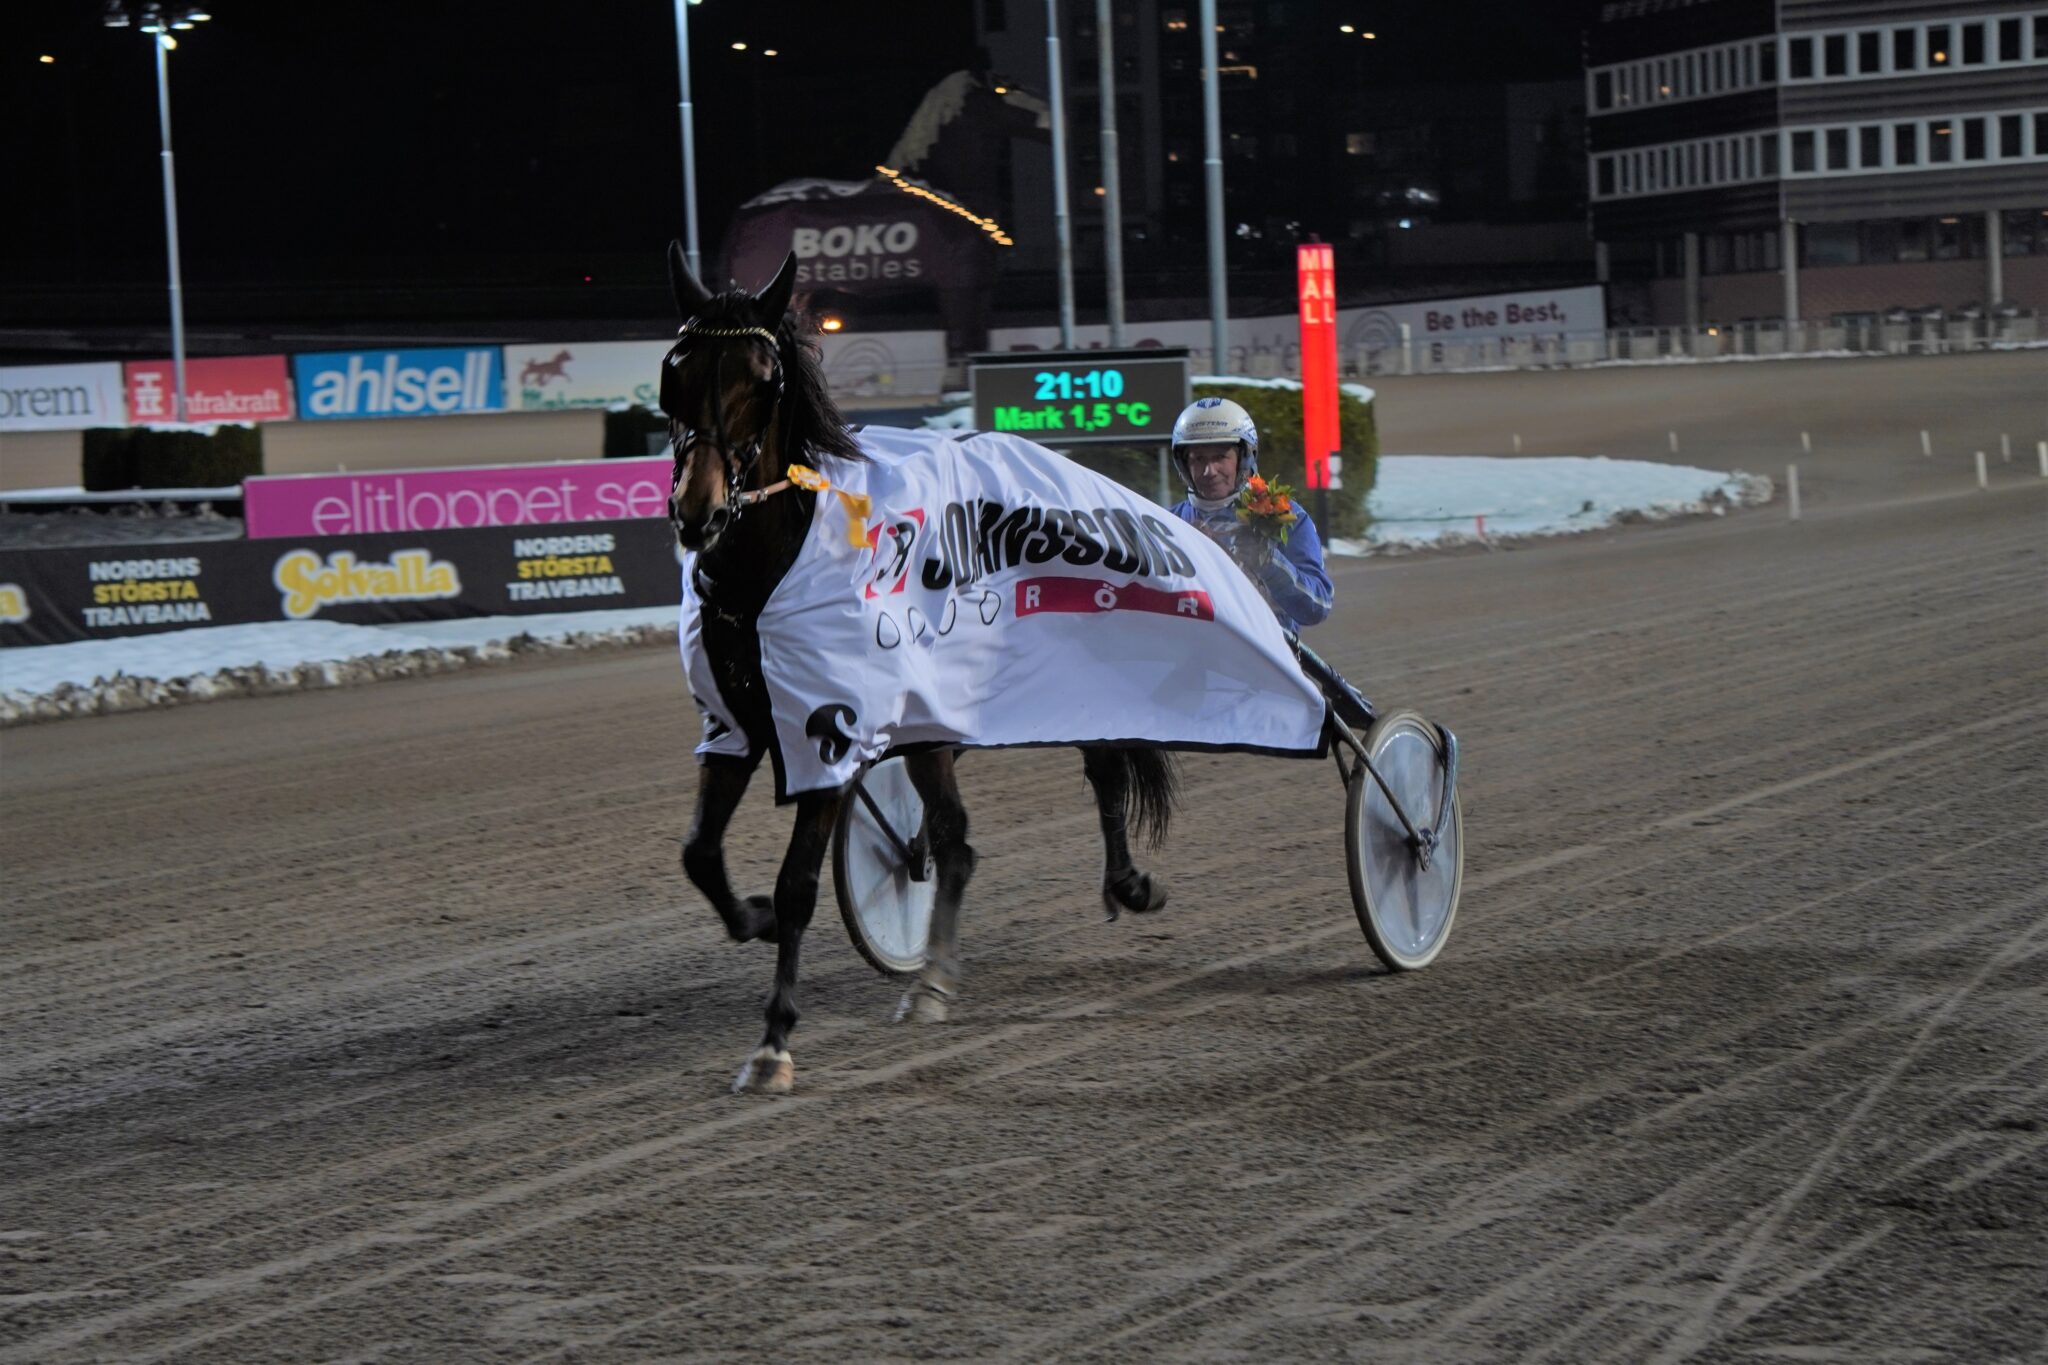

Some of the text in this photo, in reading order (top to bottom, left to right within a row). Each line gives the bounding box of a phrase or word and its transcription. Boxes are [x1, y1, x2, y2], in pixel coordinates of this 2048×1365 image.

[792, 221, 918, 258] BOKO
[797, 257, 921, 283] stables
[1426, 301, 1567, 332] Be the Best,
[309, 352, 493, 416] ahlsell
[1035, 369, 1124, 400] 21:10
[994, 406, 1065, 431] Mark
[1071, 404, 1112, 432] 1,5
[312, 478, 663, 536] elitloppet.se
[514, 533, 615, 558] NORDENS
[89, 557, 201, 582] NORDENS
[517, 554, 613, 581] STÖRSTA
[93, 580, 199, 604] STÖRSTA
[273, 547, 462, 621] Solvalla
[506, 576, 625, 602] TRAVBANA
[83, 601, 212, 627] TRAVBANA
